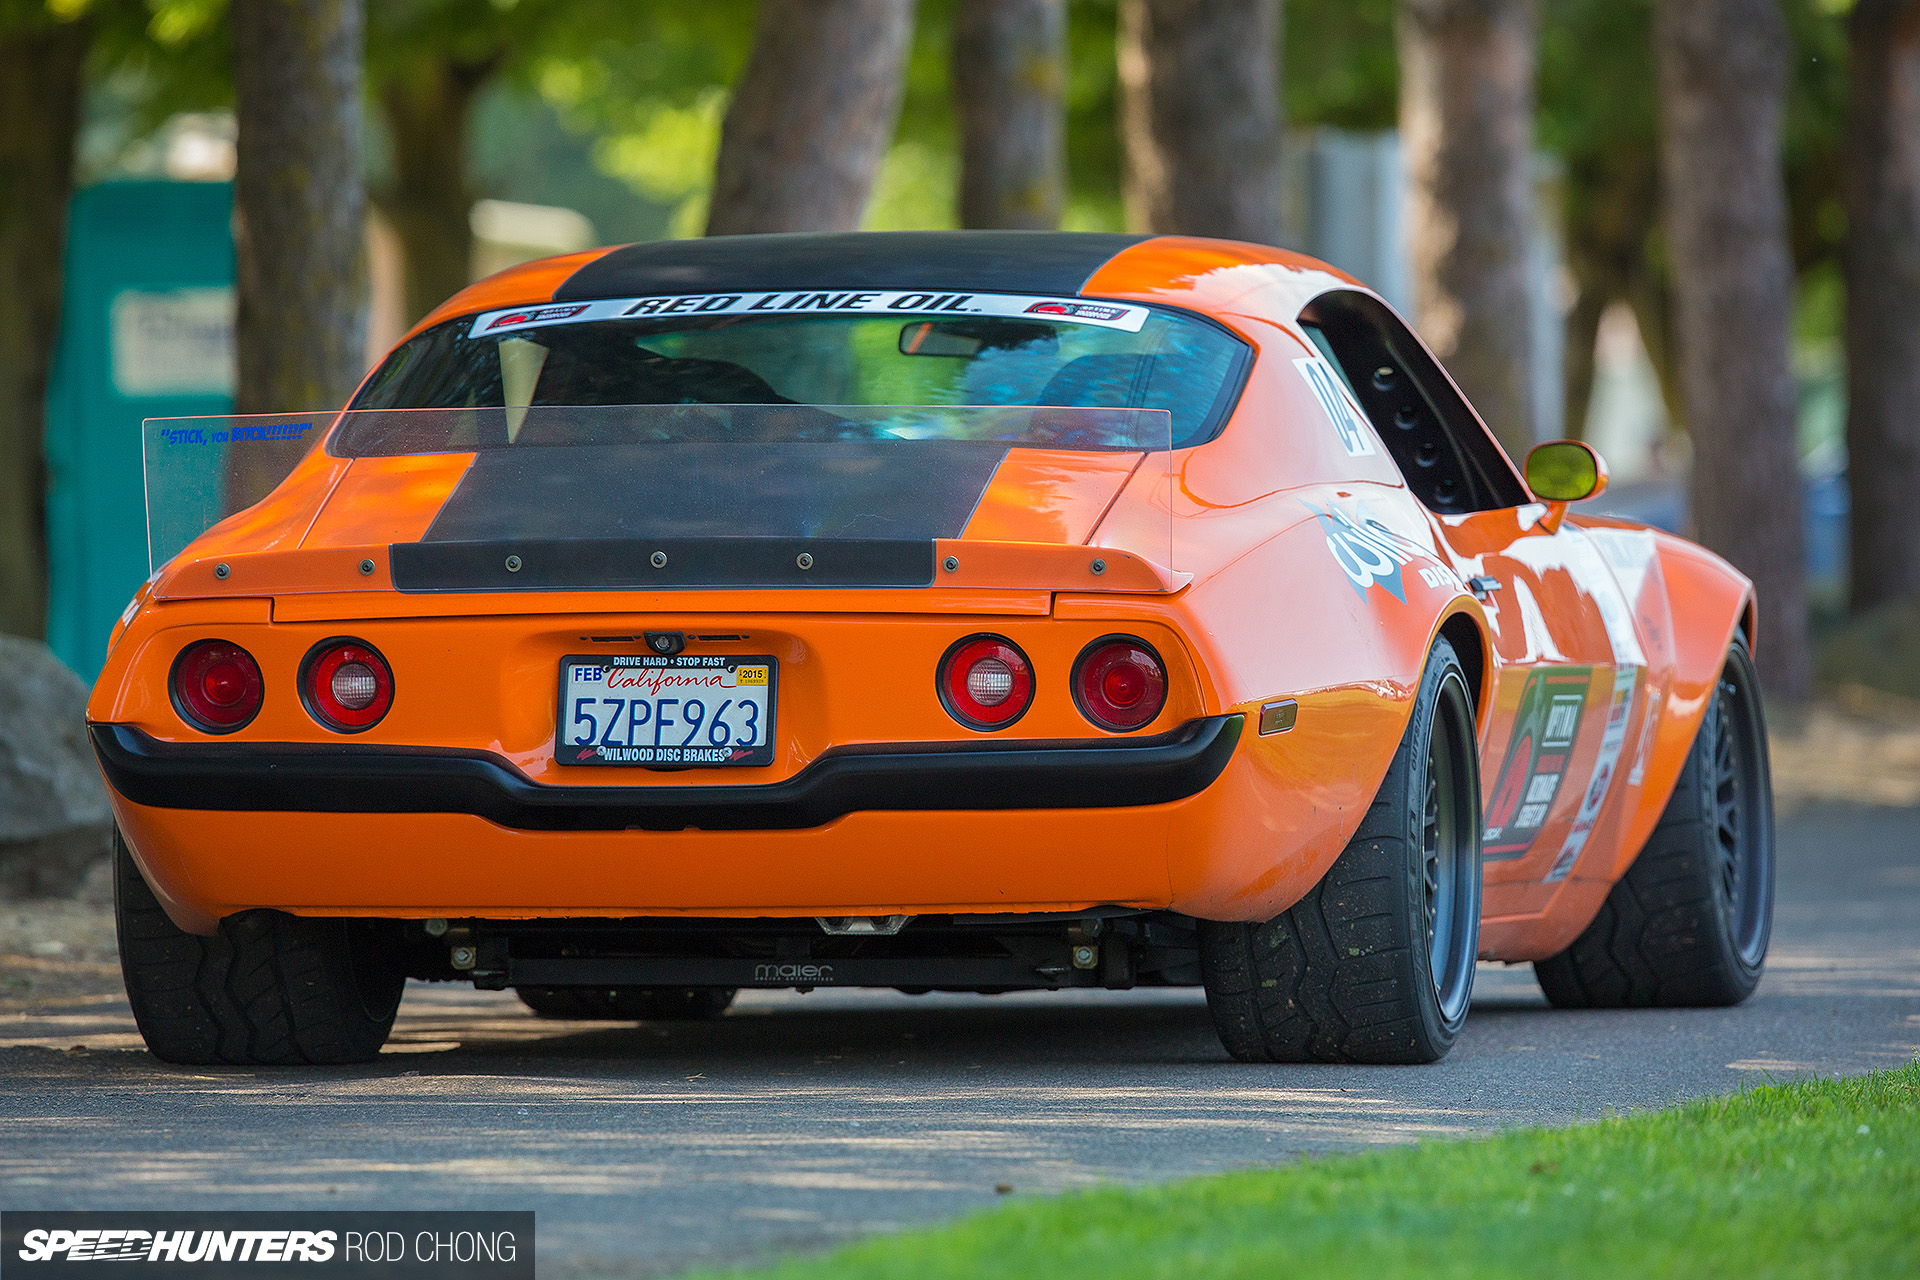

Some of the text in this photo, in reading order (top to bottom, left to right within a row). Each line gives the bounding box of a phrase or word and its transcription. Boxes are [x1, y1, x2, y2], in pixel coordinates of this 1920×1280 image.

[622, 296, 743, 316] RED
[747, 293, 882, 310] LINE
[613, 657, 726, 667] DRIVE HARD STOP FAST
[575, 667, 603, 682] FEB
[742, 669, 763, 679] 2015
[607, 668, 737, 696] California
[574, 697, 760, 746] 5ZPF963
[603, 748, 726, 762] WILWOOD DISC BRAKES
[754, 964, 833, 977] maier
